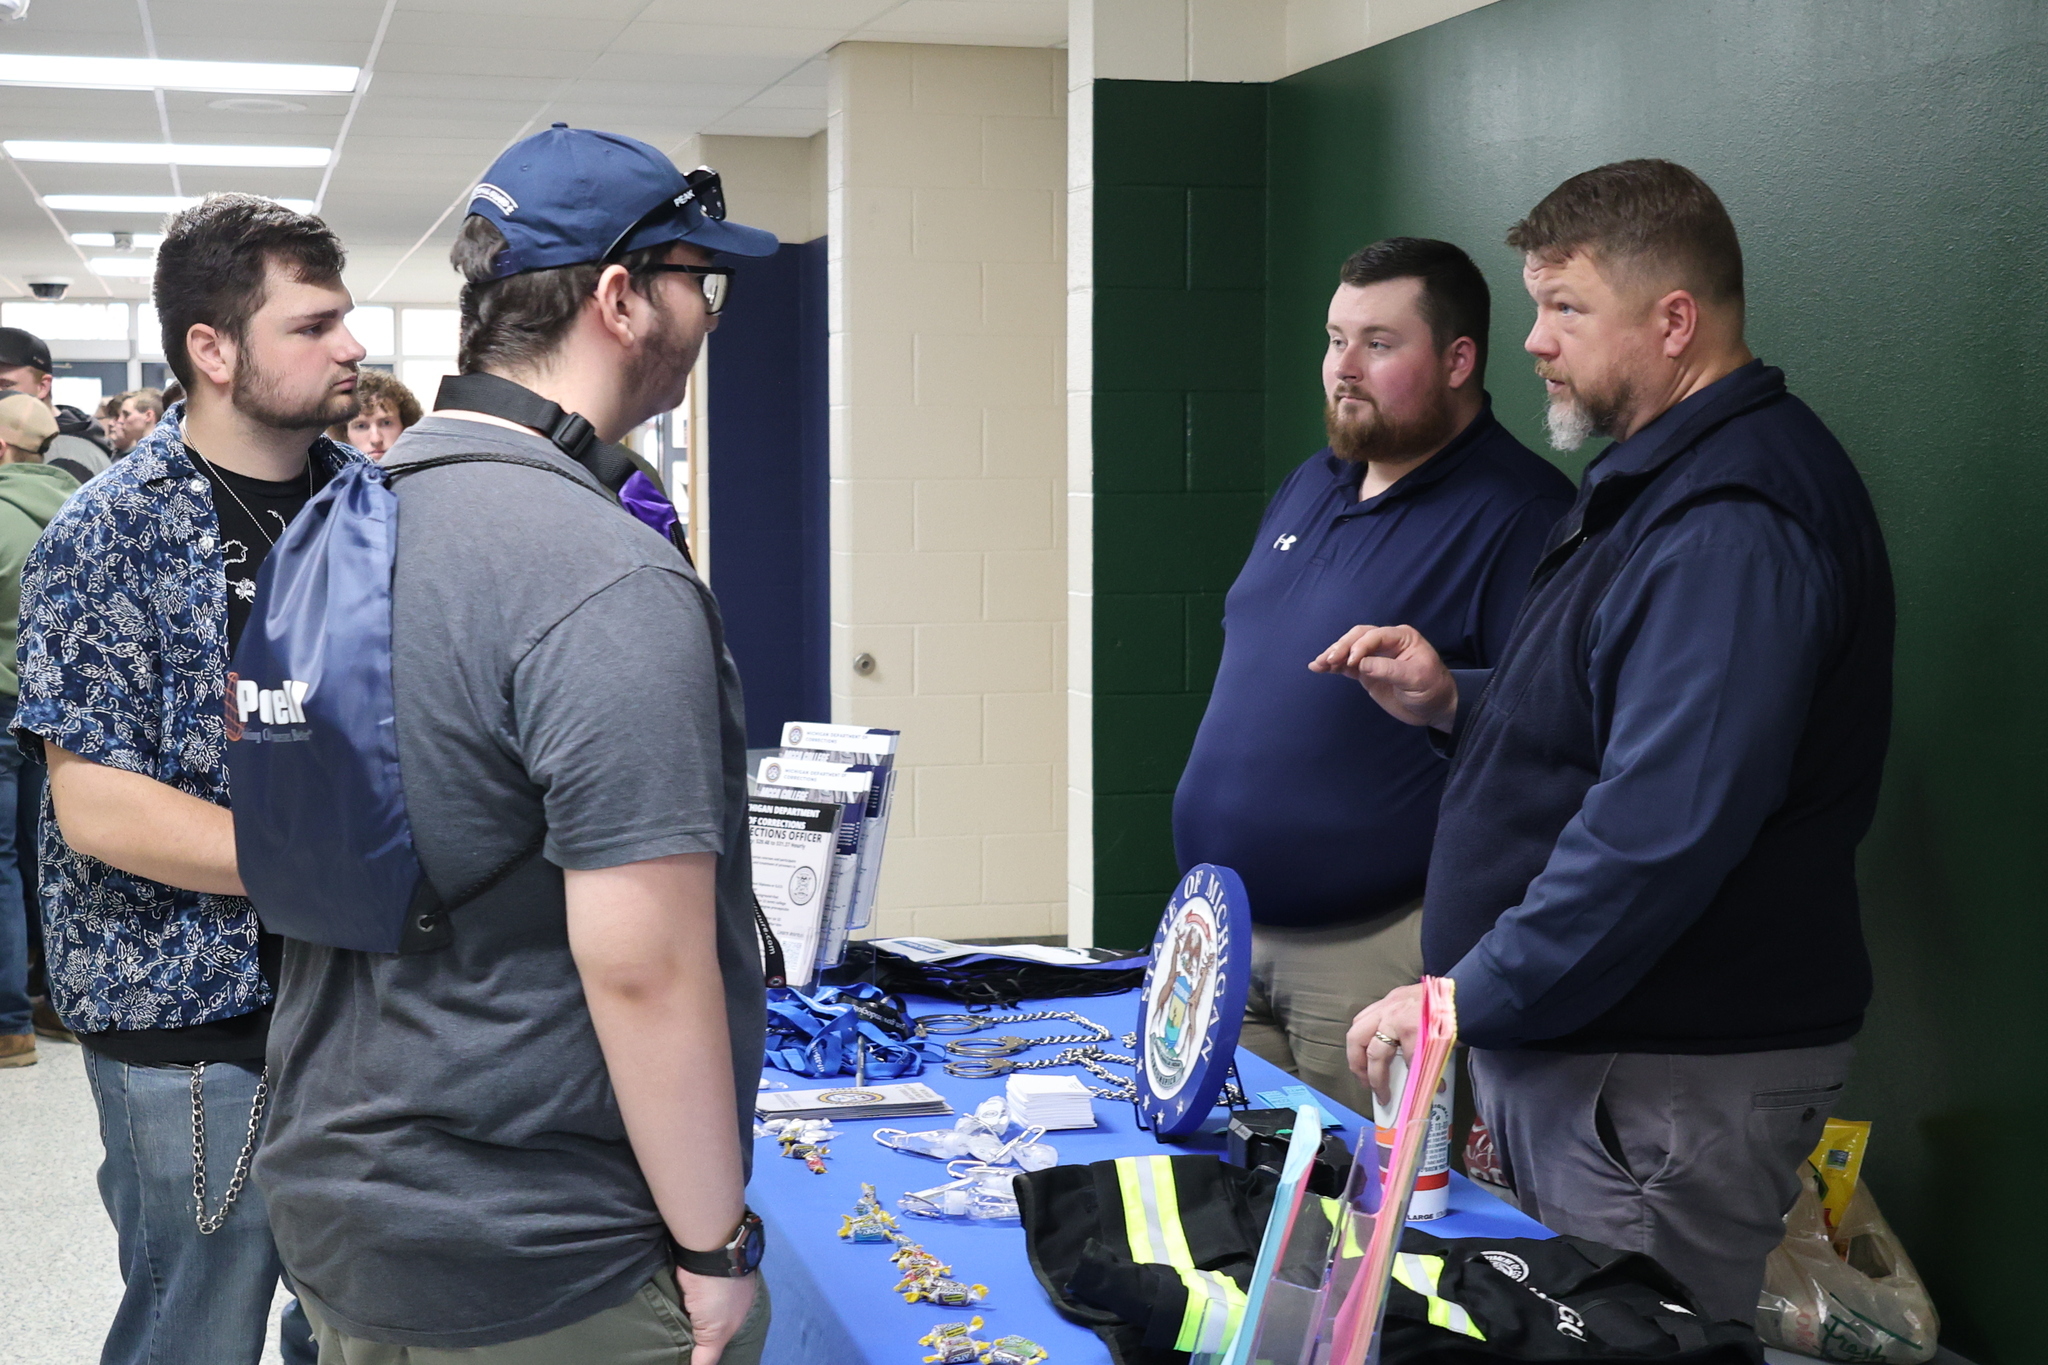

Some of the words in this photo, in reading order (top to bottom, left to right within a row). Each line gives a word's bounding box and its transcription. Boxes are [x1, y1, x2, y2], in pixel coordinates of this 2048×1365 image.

[773, 805, 821, 818] DEPARTMENT
[757, 817, 807, 830] CORRECTIONS
[788, 830, 823, 843] OFFICER
[1183, 869, 1204, 900] OF
[1200, 872, 1229, 1063] MICHIGAN
[1407, 1212, 1434, 1221] LARGE
